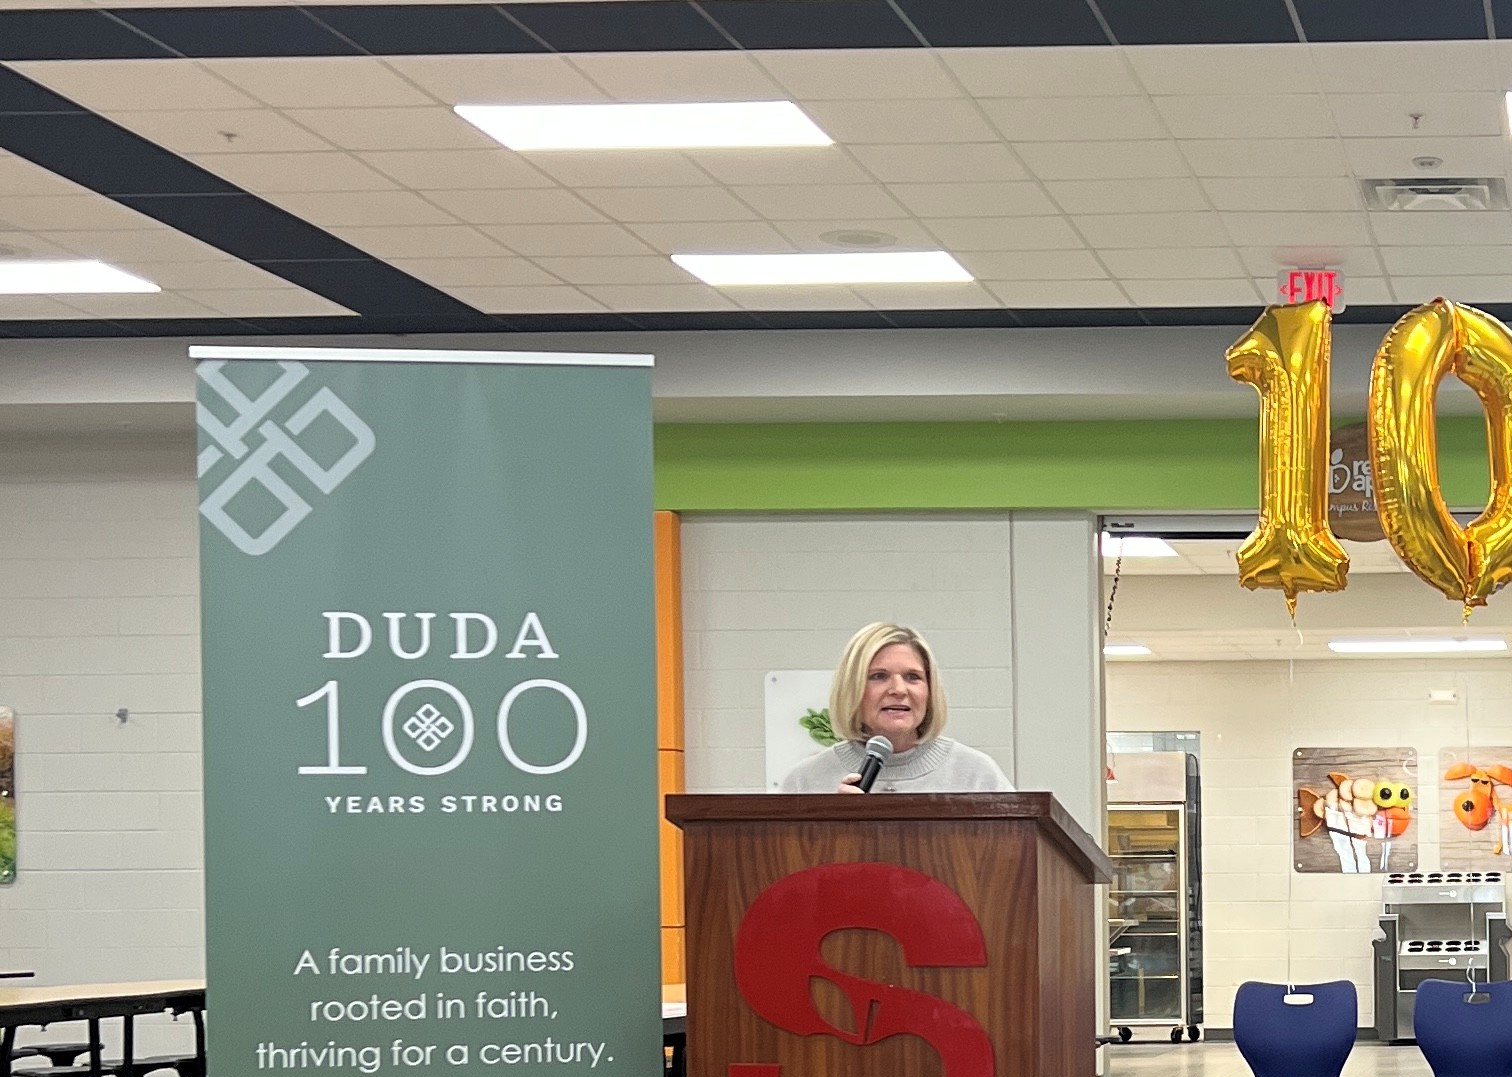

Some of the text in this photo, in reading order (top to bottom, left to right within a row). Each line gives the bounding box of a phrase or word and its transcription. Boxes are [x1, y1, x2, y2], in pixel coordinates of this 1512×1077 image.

[1288, 271, 1337, 308] EXIT
[322, 611, 559, 659] DUDA
[296, 678, 588, 775] 100
[325, 794, 563, 814] YEARS STRONG
[293, 945, 575, 979] A family business
[310, 990, 559, 1022] rooted in faith,
[256, 1037, 615, 1074] thriving for a century.
